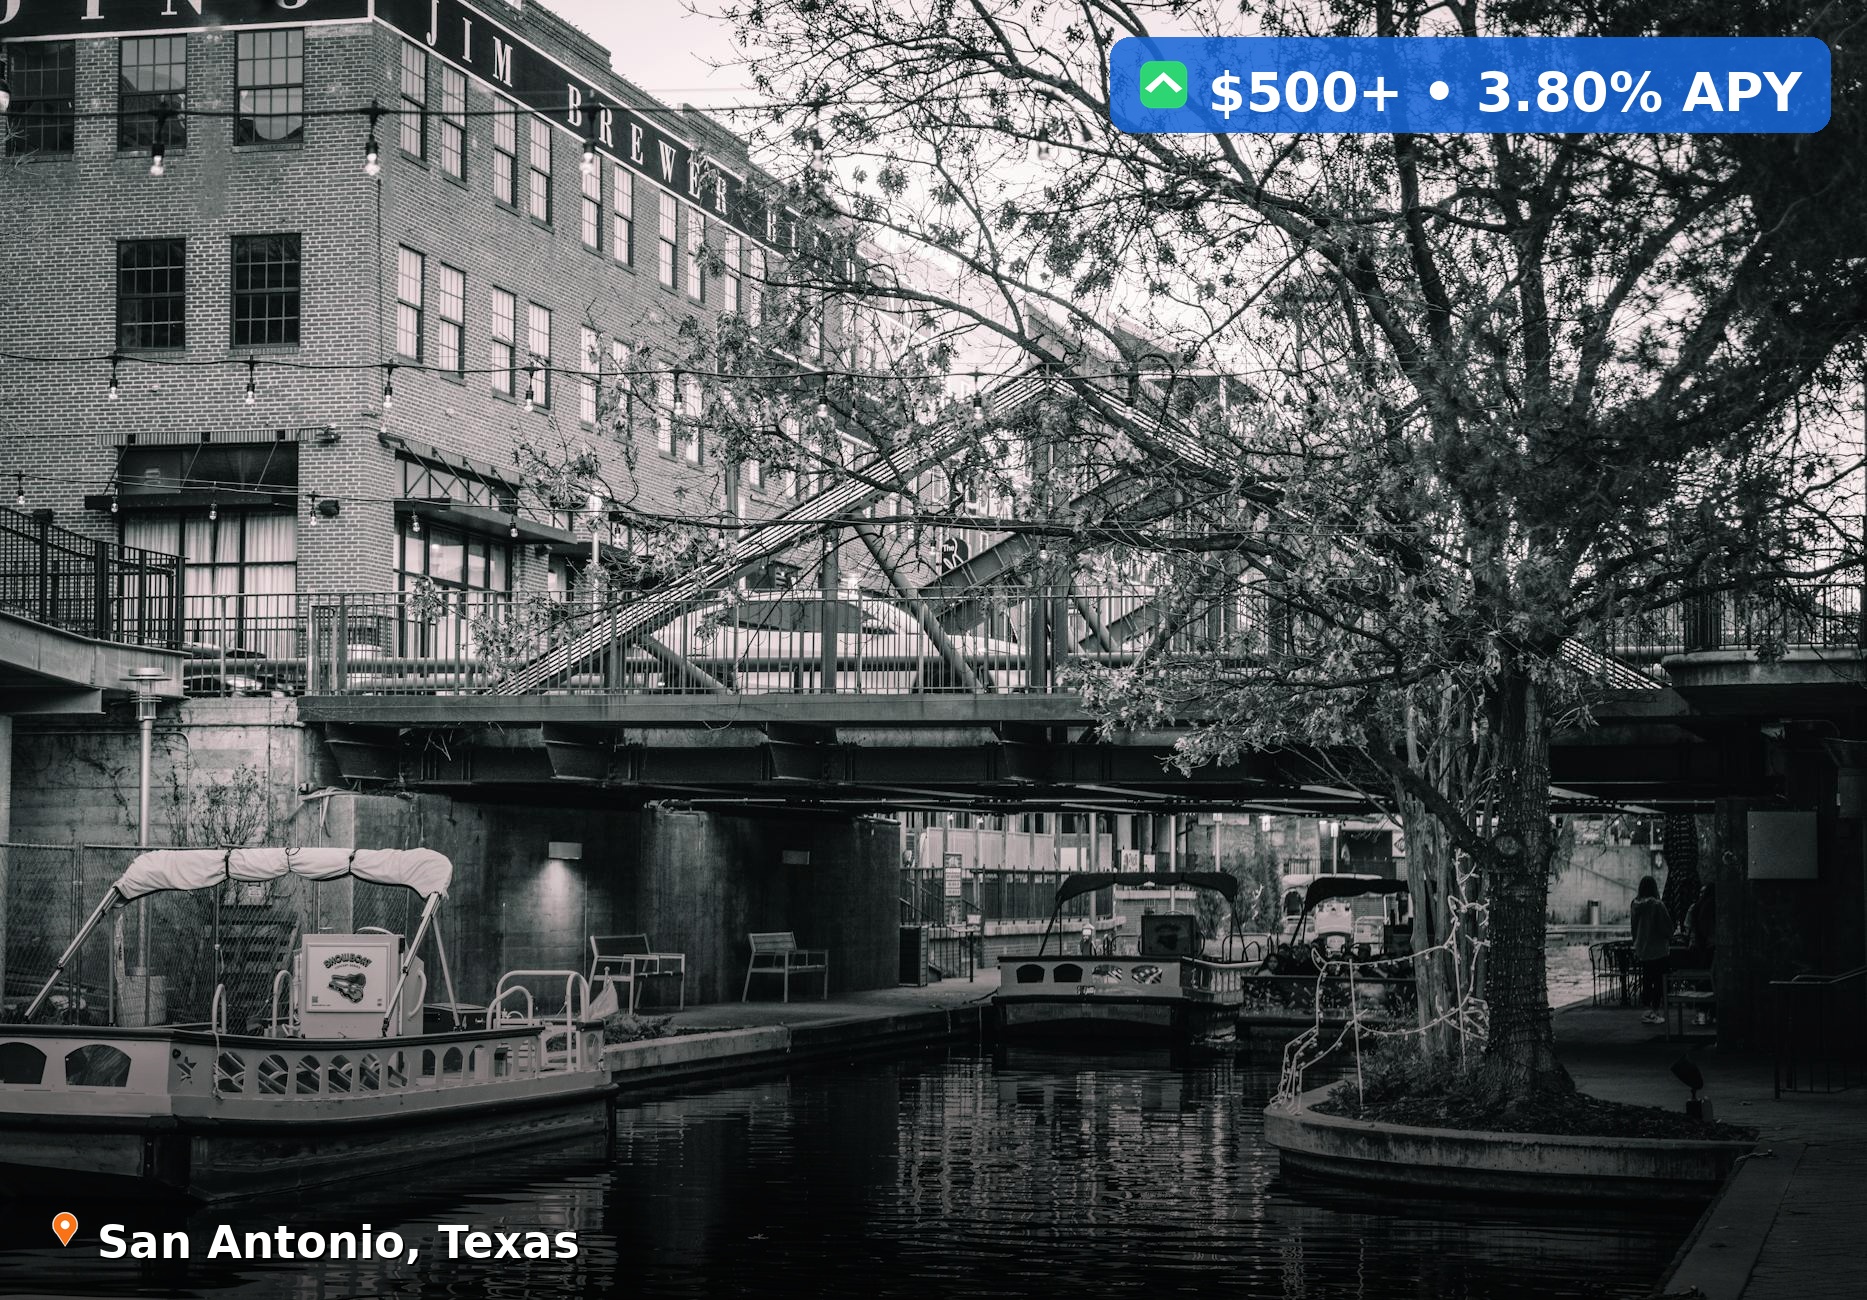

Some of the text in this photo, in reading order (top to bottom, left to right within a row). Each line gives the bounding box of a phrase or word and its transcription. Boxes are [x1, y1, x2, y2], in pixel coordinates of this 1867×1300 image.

[427, 0, 728, 214] JIM BREWER
[323, 953, 372, 969] SHOWBOAT
